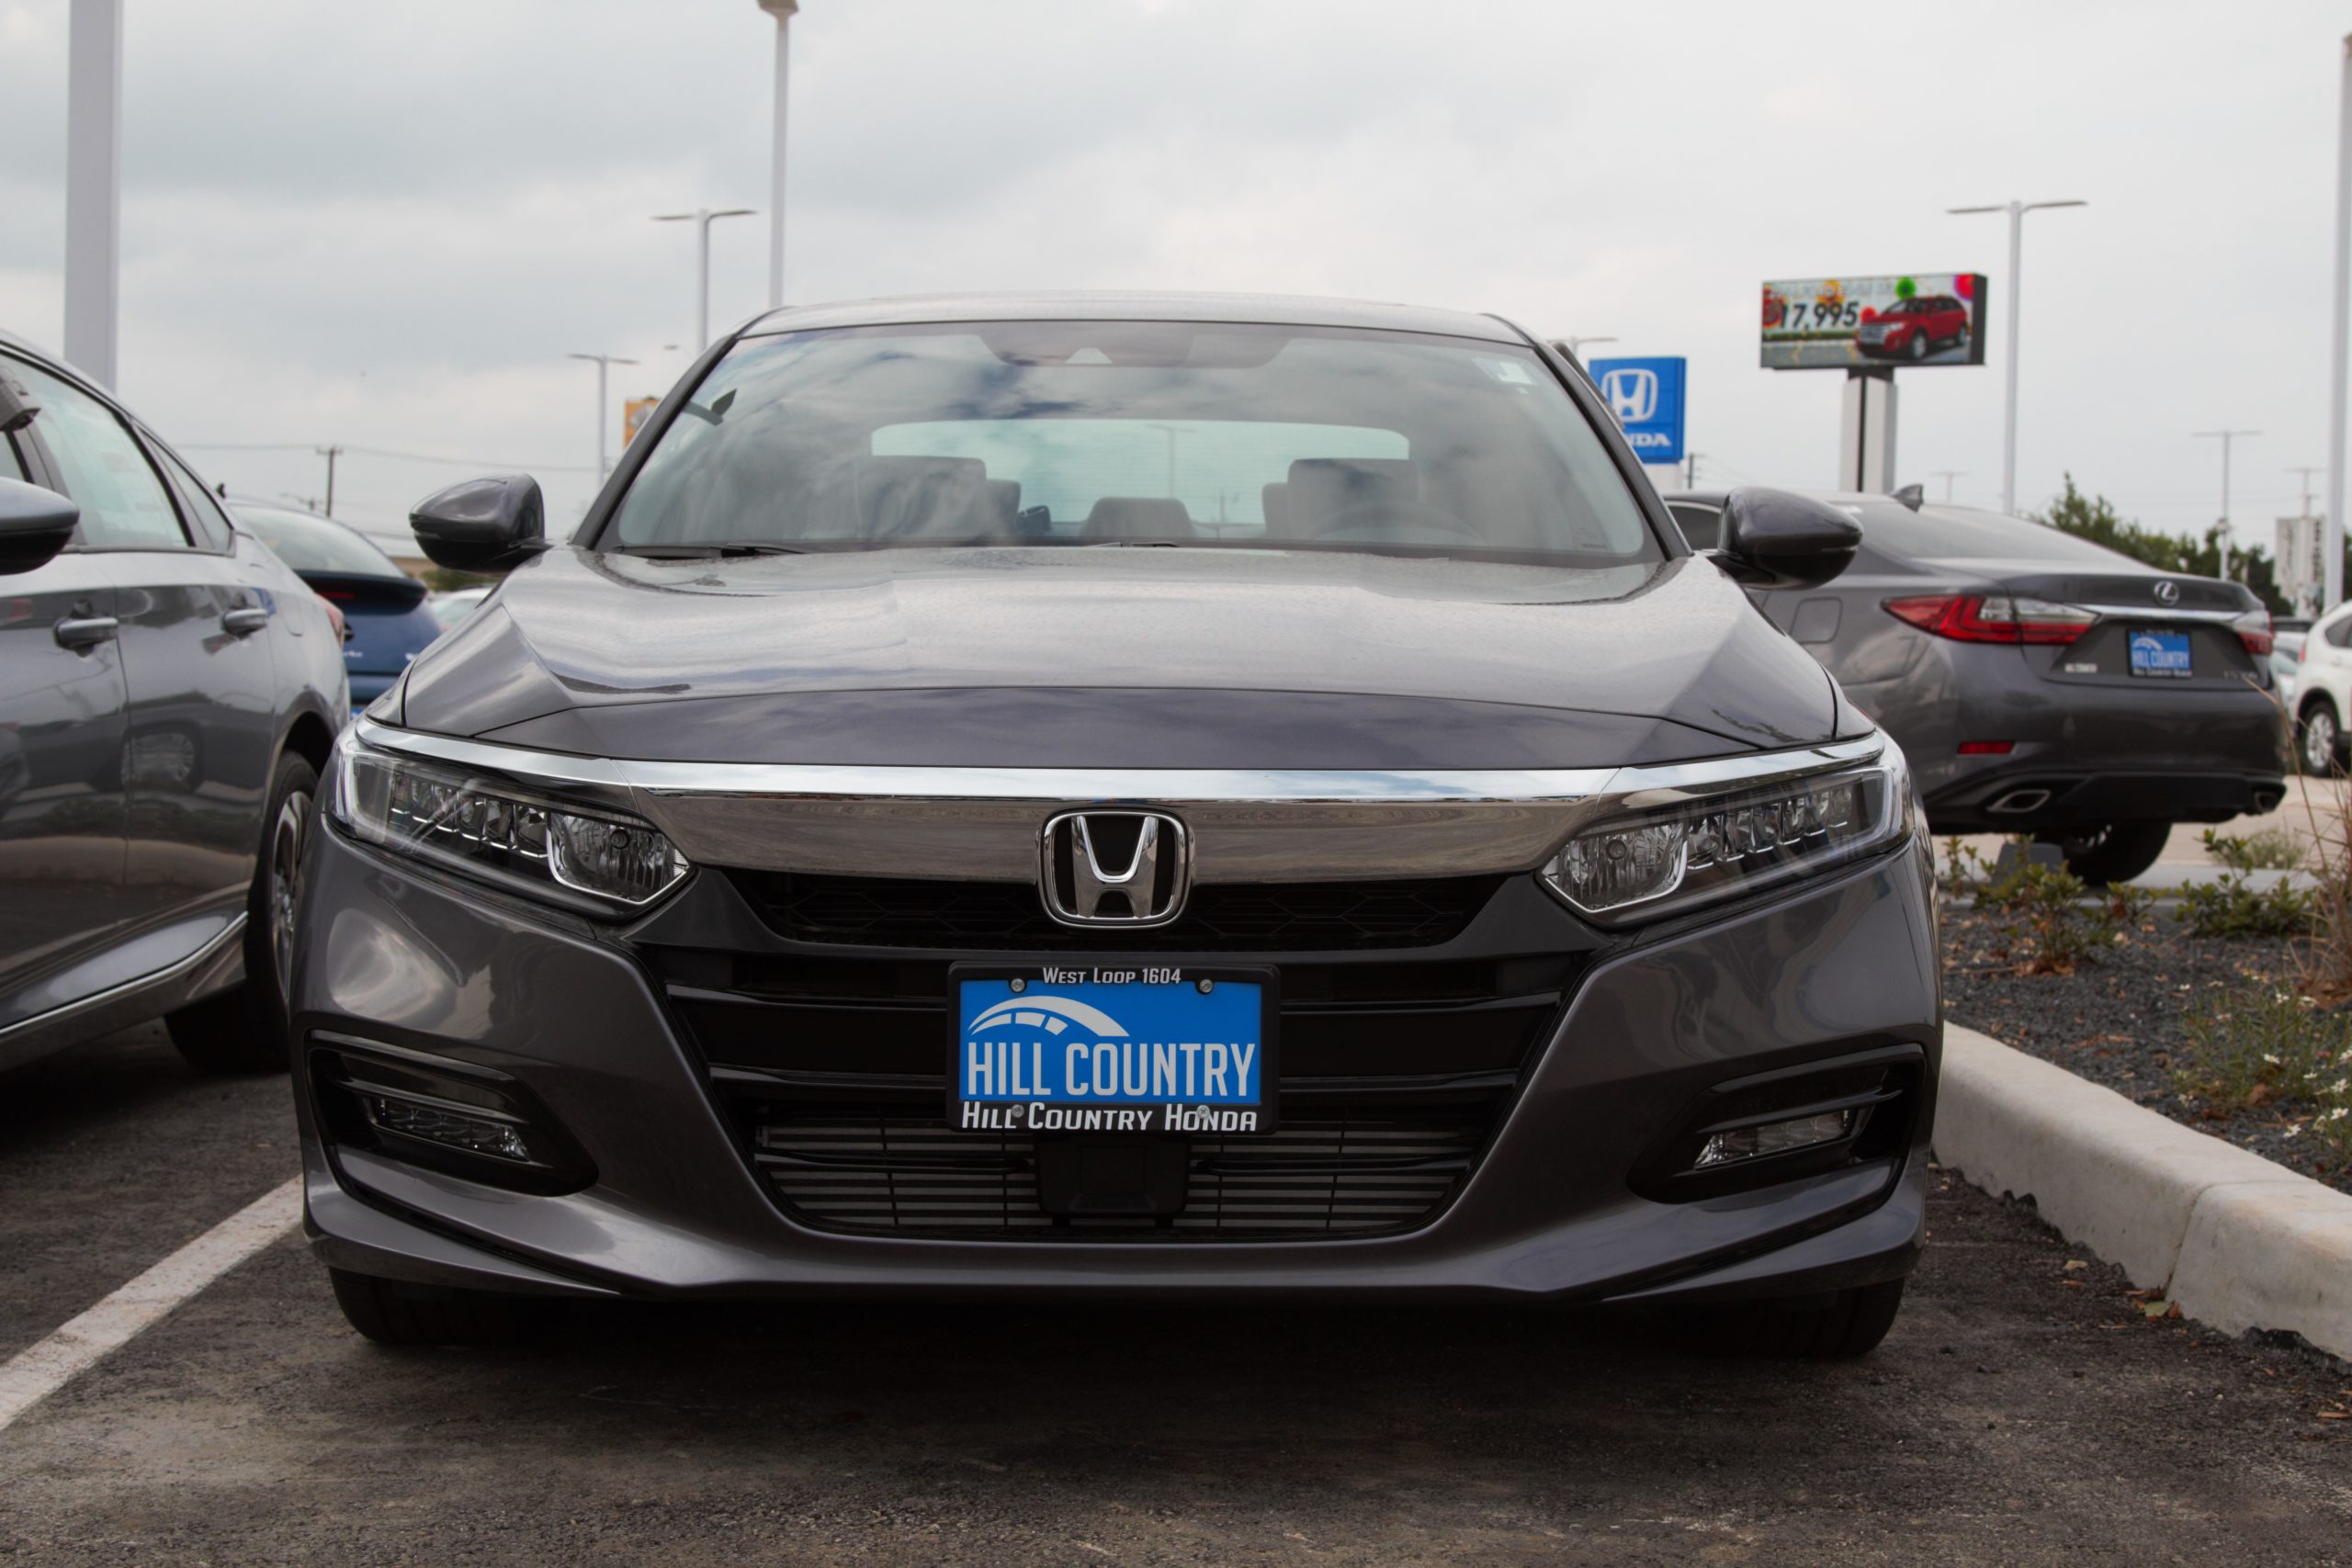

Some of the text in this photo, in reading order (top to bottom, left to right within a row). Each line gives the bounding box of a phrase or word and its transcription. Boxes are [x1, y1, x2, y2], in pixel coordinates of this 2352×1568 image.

[1780, 300, 1860, 330] 17,995
[1043, 967, 1182, 984] WEST LOOP 1604
[967, 1042, 1255, 1097] HILL COUNTRY
[1027, 1101, 1153, 1131] COUNTRY
